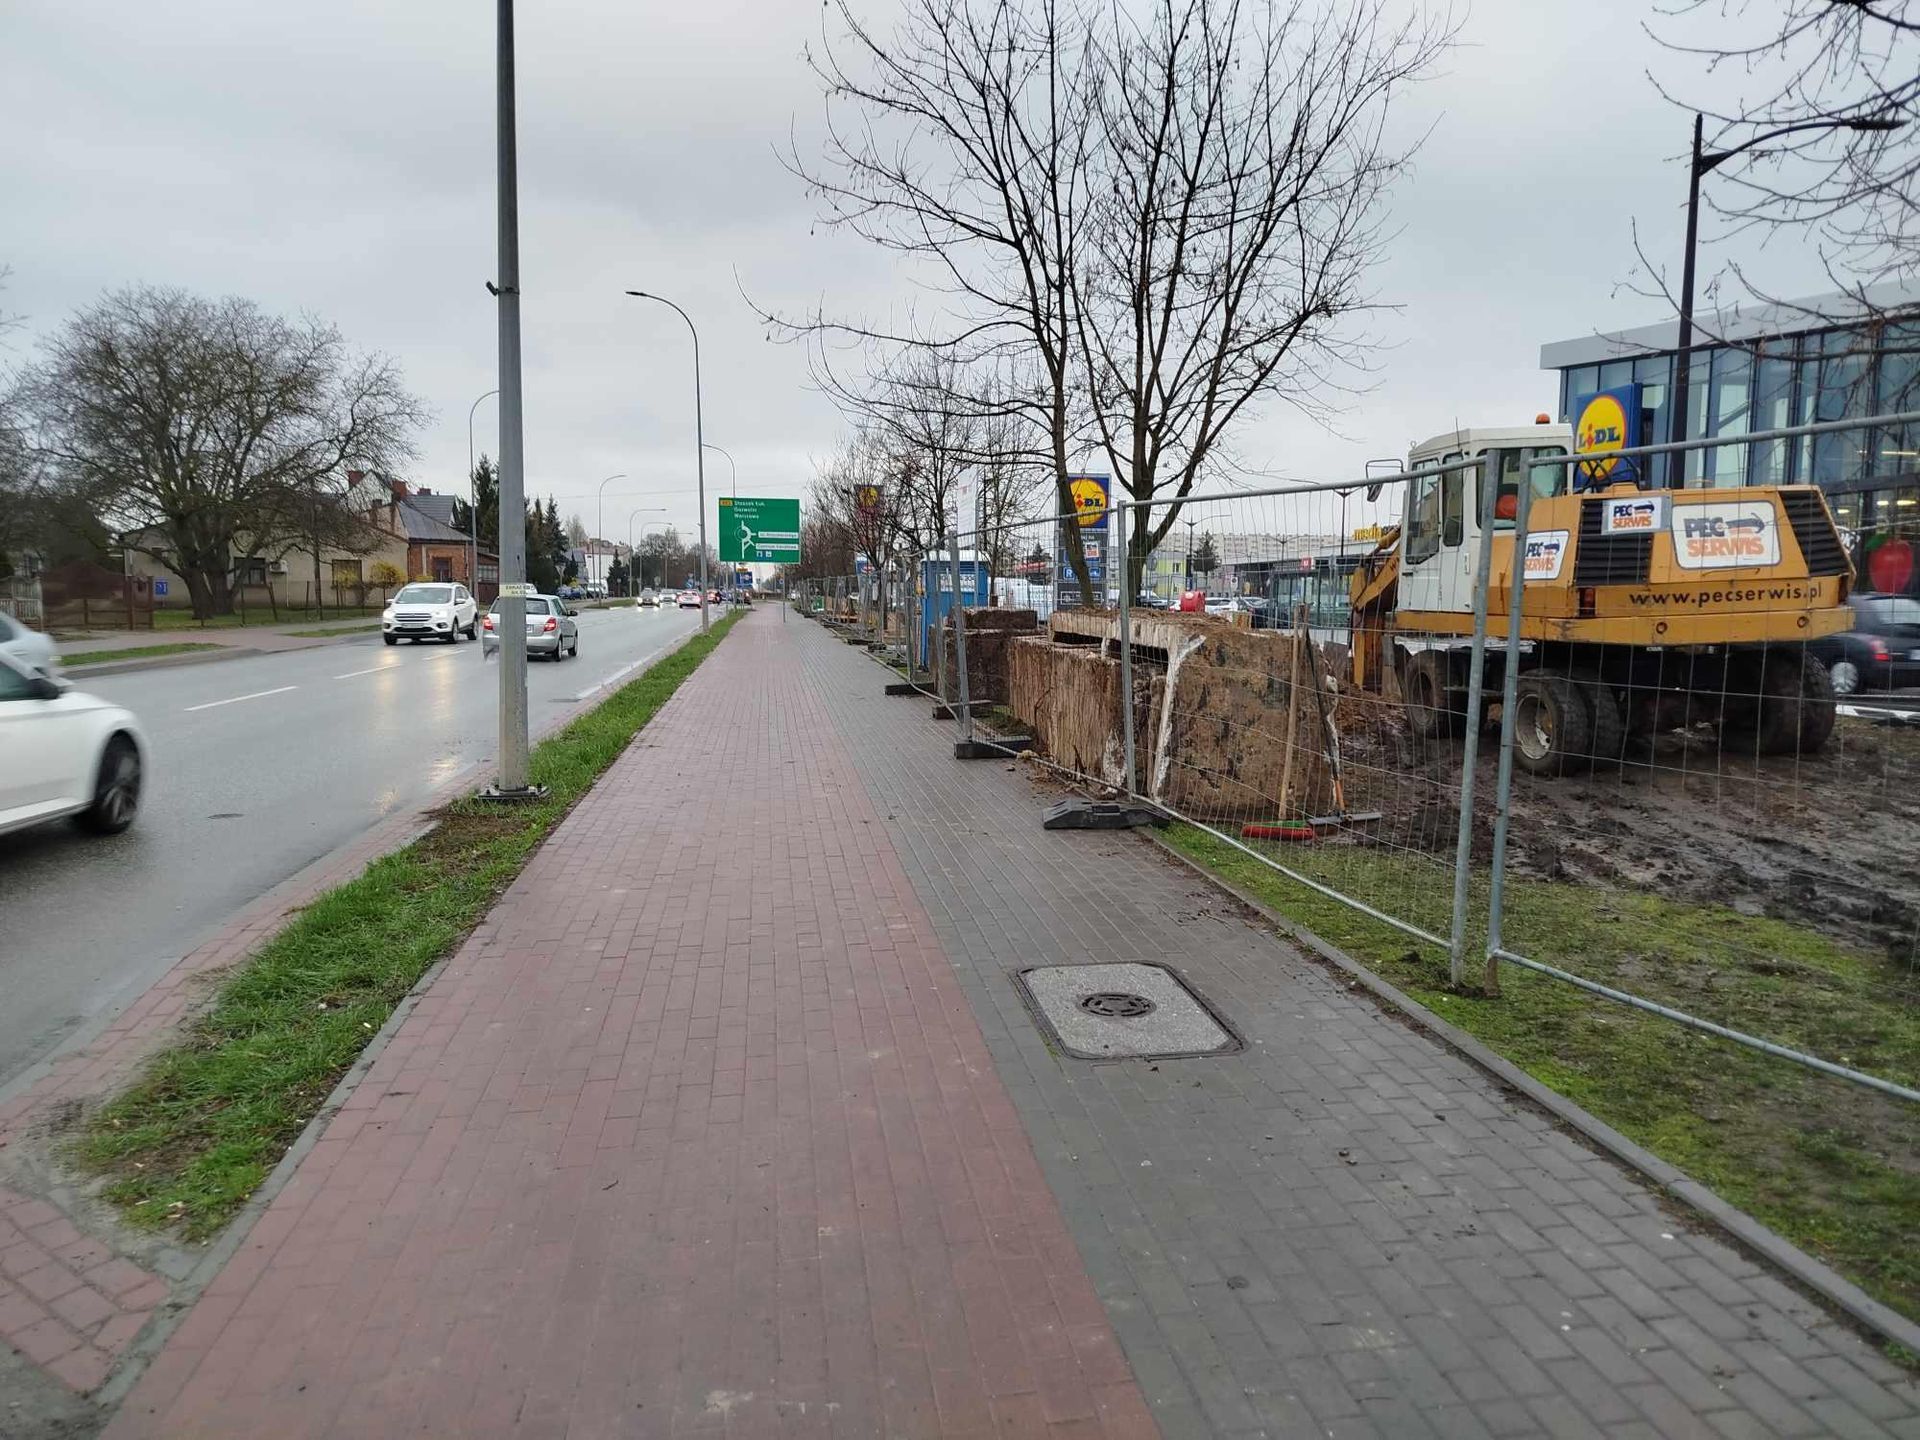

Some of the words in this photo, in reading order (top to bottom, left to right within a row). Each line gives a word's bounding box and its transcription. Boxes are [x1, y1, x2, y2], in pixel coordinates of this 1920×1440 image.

[1613, 504, 1633, 517] PEC
[1612, 516, 1652, 528] SERWIS
[1684, 517, 1725, 538] PEC
[1527, 542, 1544, 557] PEC
[1687, 537, 1764, 558] SERWIS
[1629, 583, 1822, 608] www.pecserwis.pl
